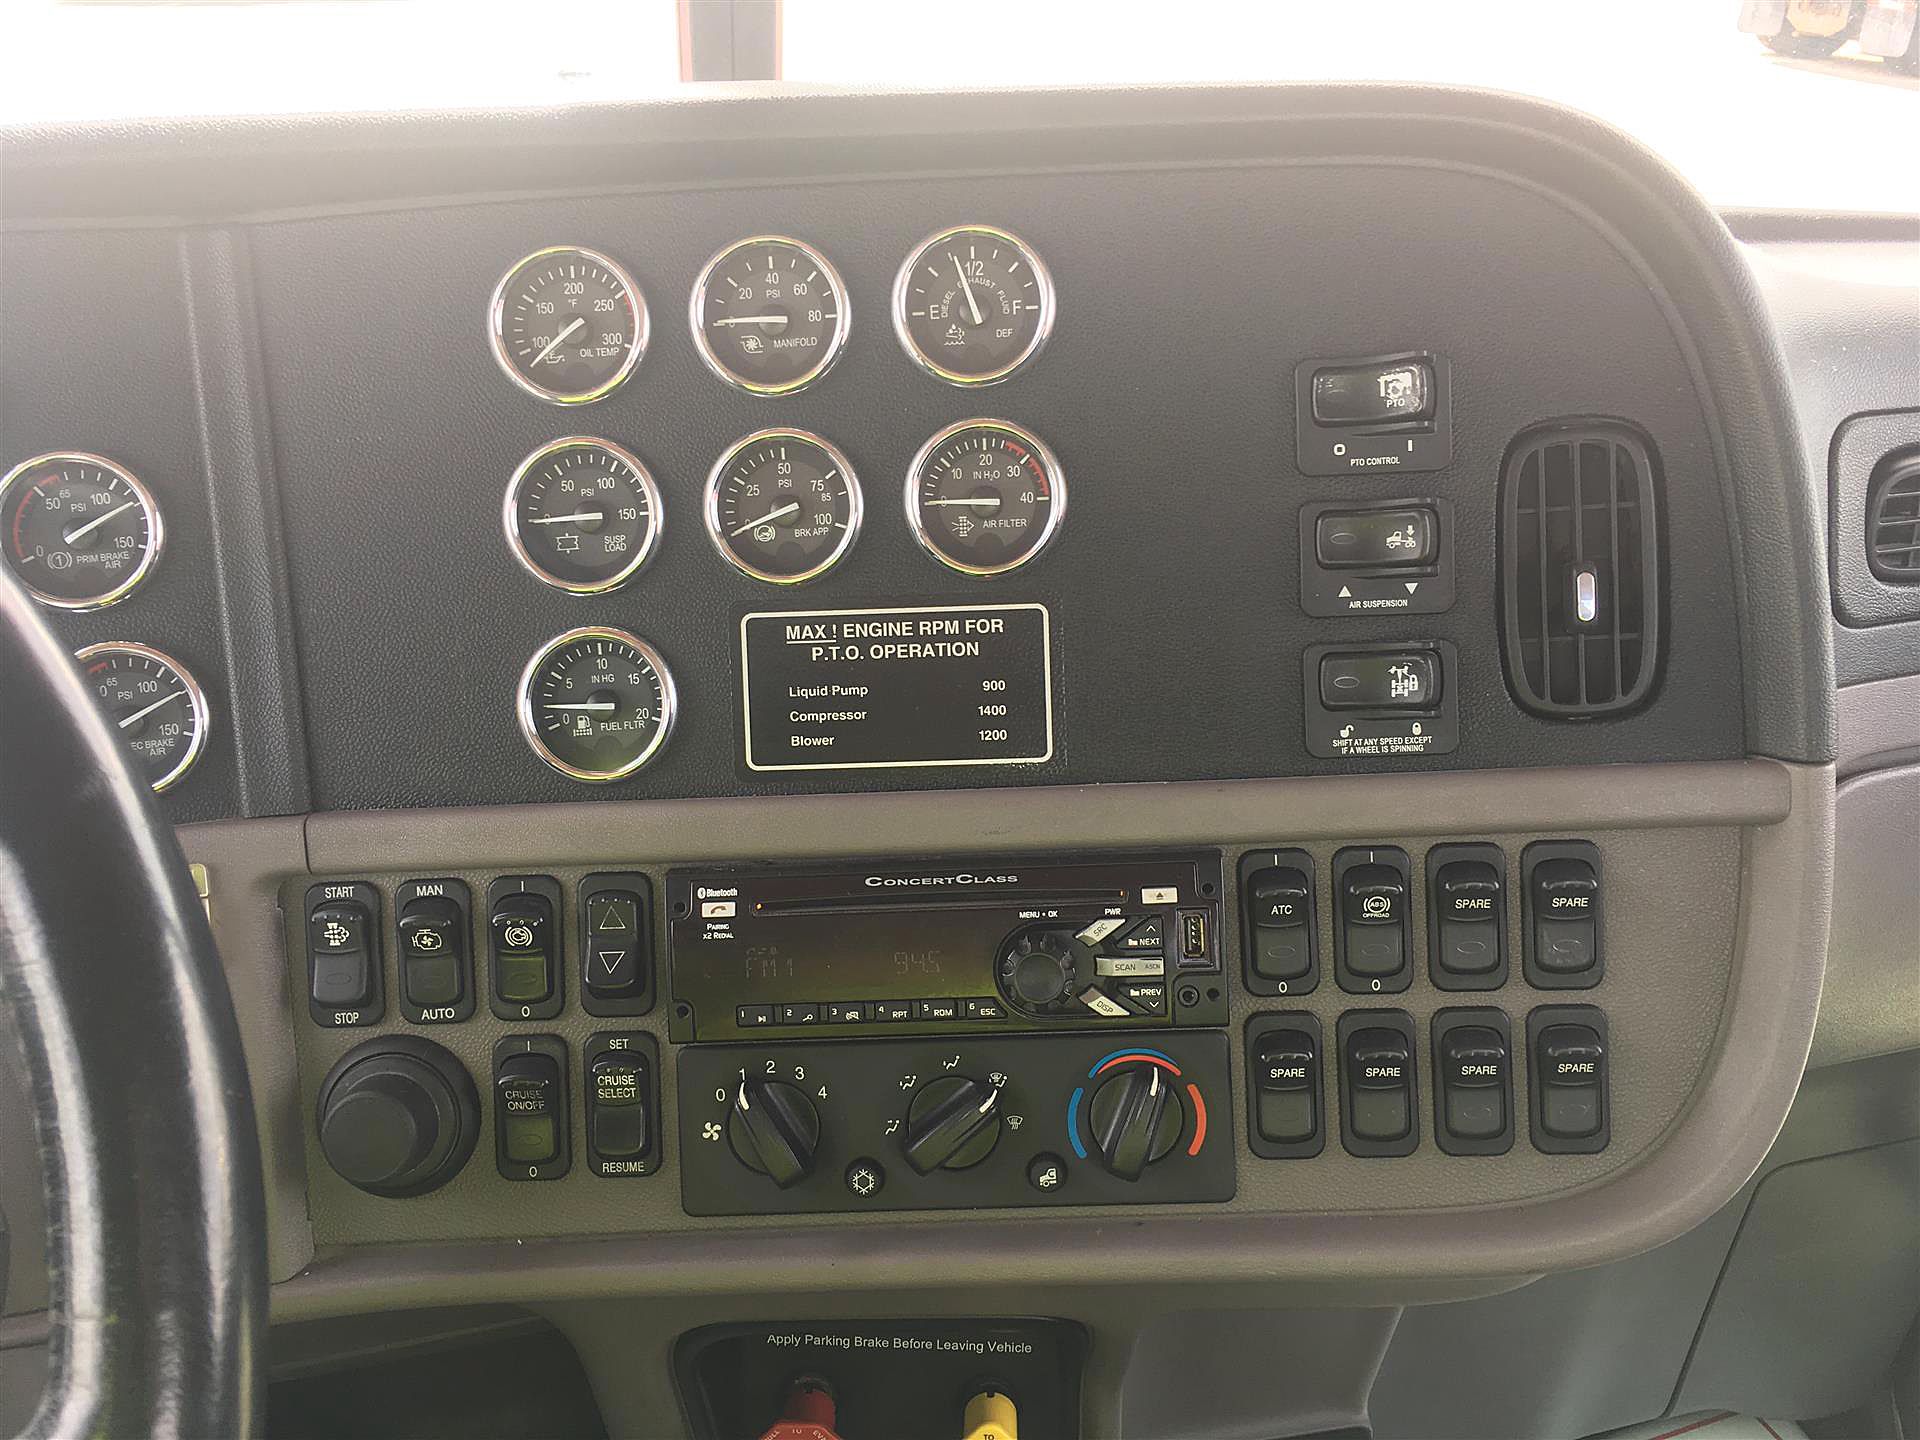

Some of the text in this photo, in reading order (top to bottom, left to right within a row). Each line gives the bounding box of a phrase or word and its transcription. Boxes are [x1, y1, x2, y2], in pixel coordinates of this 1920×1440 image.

[964, 261, 984, 276] 1/2
[765, 273, 779, 284] 40
[564, 283, 584, 295] 200
[739, 288, 752, 299] 20
[766, 289, 781, 298] PSI
[794, 284, 807, 295] 60
[941, 277, 1009, 318] DIESEL EHAUST FLUID
[536, 303, 554, 315] 150
[594, 300, 614, 311] 250
[1013, 300, 1021, 315] F
[808, 310, 822, 321] 80
[930, 305, 940, 319] E
[602, 333, 622, 344] 300
[996, 329, 1012, 338] DEF
[532, 336, 550, 348] 100
[773, 337, 818, 348] MANIFOLD
[580, 347, 620, 357] OIL TEMP
[1386, 398, 1405, 408] PTO
[979, 454, 993, 466] 20
[1350, 456, 1400, 467] PTO CONTROL
[777, 463, 791, 474] 50
[951, 468, 962, 479] 10
[1007, 466, 1020, 476] 30
[973, 471, 983, 479] IN
[561, 480, 575, 492] 50
[597, 478, 615, 490] 100
[778, 479, 792, 488] PSI
[810, 480, 825, 492] 75
[59, 489, 71, 498] 65
[581, 488, 594, 497] PSI
[747, 485, 760, 496] 25
[90, 493, 111, 505] 100
[821, 493, 831, 502] 85
[1020, 492, 1034, 504] 40
[46, 498, 60, 510] 50
[71, 503, 87, 512] PSI
[617, 508, 636, 520] 150
[814, 514, 832, 525] 100
[983, 519, 1027, 528] AIR FILTER
[794, 527, 829, 538] BRK APP
[113, 536, 134, 548] 150
[604, 535, 626, 544] SUSP
[36, 545, 44, 557] 0
[605, 542, 626, 552] LOAD
[76, 551, 129, 563] PRIM BRAKE
[105, 560, 121, 568] AIR
[1362, 599, 1408, 608] SUSPENSION
[786, 624, 827, 641] MAX
[843, 622, 913, 638] ENGINE
[919, 619, 960, 636] RPM
[965, 618, 1004, 634] FOR
[811, 642, 979, 661] P.T.O. OPERATION
[596, 658, 607, 669] 10
[107, 678, 117, 686] 65
[566, 678, 573, 689] 5
[602, 674, 615, 682] HG
[628, 673, 640, 685] 15
[137, 681, 157, 693] 100
[982, 680, 1005, 692] 900
[118, 691, 133, 700] PSI
[789, 685, 869, 699] Liquid Pump
[636, 708, 649, 719] 20
[978, 704, 1007, 716] 1400
[563, 713, 569, 725] 0
[789, 710, 867, 723] Compressor
[159, 723, 179, 735] 150
[601, 721, 645, 731] FUEL FLTR
[978, 729, 1008, 741] 1200
[145, 739, 174, 748] BRAKE
[791, 735, 834, 748] Blower
[1333, 739, 1352, 747] SHIFT
[1364, 738, 1378, 746] ANY
[1380, 737, 1403, 745] SPEED
[1405, 736, 1432, 744] EXCEPT
[1356, 746, 1380, 754] WHEEL
[325, 886, 355, 898] START
[416, 885, 443, 896] MAN
[706, 888, 738, 897] Bluetooth
[1455, 899, 1492, 909] SPARE
[1552, 897, 1589, 908] SPARE
[1019, 910, 1058, 919] MENU OK
[1271, 905, 1292, 915] ATC
[1093, 923, 1107, 937] SRC
[832, 1008, 837, 1016] 3
[923, 1004, 929, 1012] 5
[981, 1008, 996, 1016] ESC
[1096, 1001, 1114, 1013] DISP
[334, 1012, 359, 1024] STOP
[421, 1007, 455, 1020] AUTO
[786, 1009, 792, 1017] 2
[892, 1010, 907, 1019] RPT
[609, 1039, 629, 1050] SET
[766, 1061, 776, 1073] 2
[1365, 1067, 1401, 1077] SPARE
[1461, 1065, 1497, 1075] SPARE
[1557, 1063, 1595, 1073] SPARE
[739, 1068, 745, 1080] 1
[795, 1067, 805, 1080] 3
[1270, 1068, 1305, 1078] SPARE
[597, 1075, 635, 1086] CRUISE
[505, 1090, 543, 1099] CRUISE
[598, 1088, 636, 1099] SELECT
[715, 1089, 726, 1101] 0
[818, 1086, 827, 1099] 4
[507, 1101, 545, 1110] ON/OFF
[602, 1162, 644, 1173] RESUME
[767, 1334, 1032, 1354] Apply Parking Brake Before Leaving Vehicle
